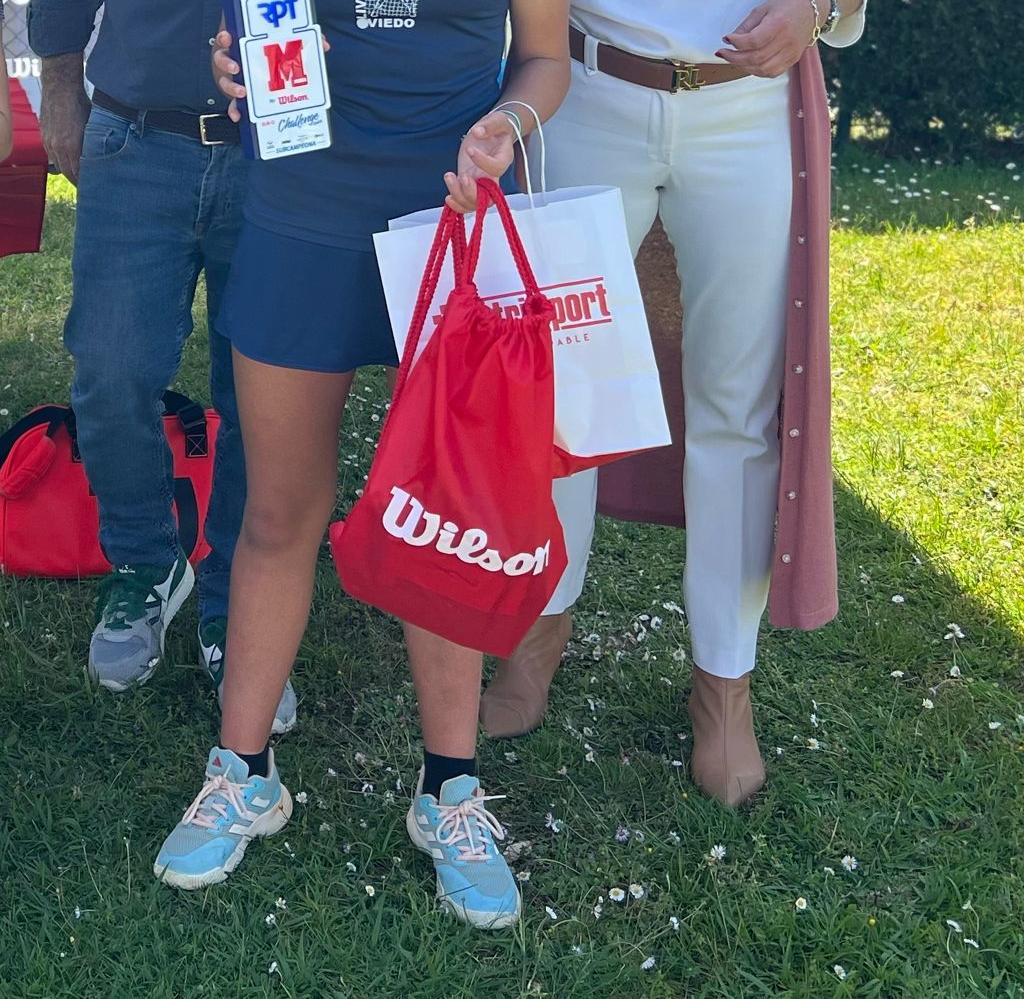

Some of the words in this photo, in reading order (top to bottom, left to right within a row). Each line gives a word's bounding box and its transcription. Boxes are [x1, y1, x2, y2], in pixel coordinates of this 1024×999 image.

[263, 39, 308, 92] M
[278, 94, 308, 105] Wilson
[278, 113, 319, 132] Challenge
